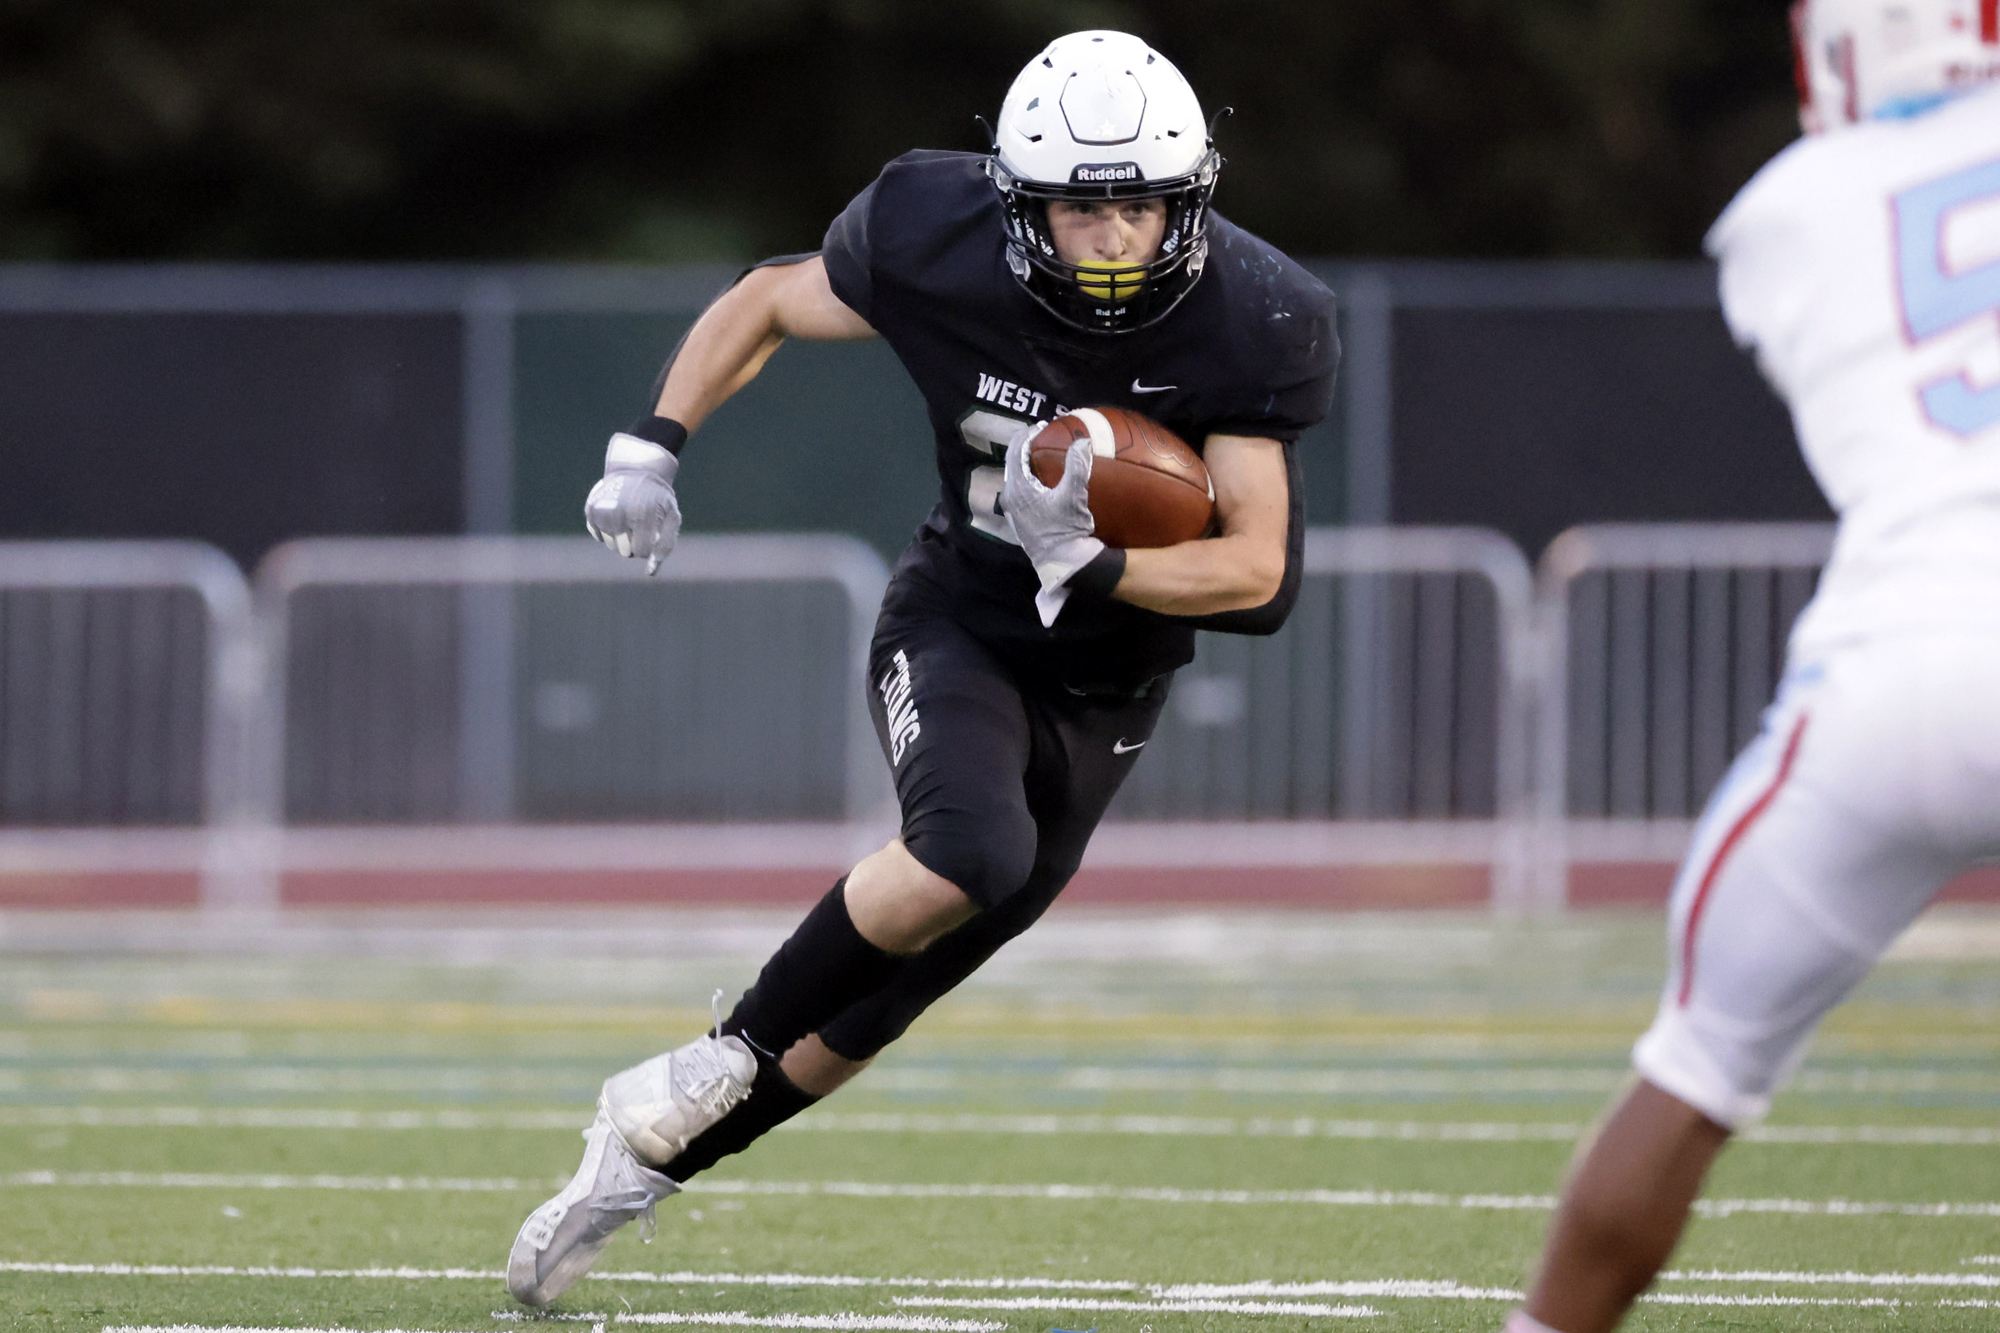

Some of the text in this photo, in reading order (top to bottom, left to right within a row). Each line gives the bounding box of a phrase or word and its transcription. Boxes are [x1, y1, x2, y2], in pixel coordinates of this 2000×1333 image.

[1077, 165, 1136, 181] Riddell
[1095, 307, 1126, 316] Ridell
[976, 372, 1047, 417] WEST
[879, 648, 921, 767] TITANS
